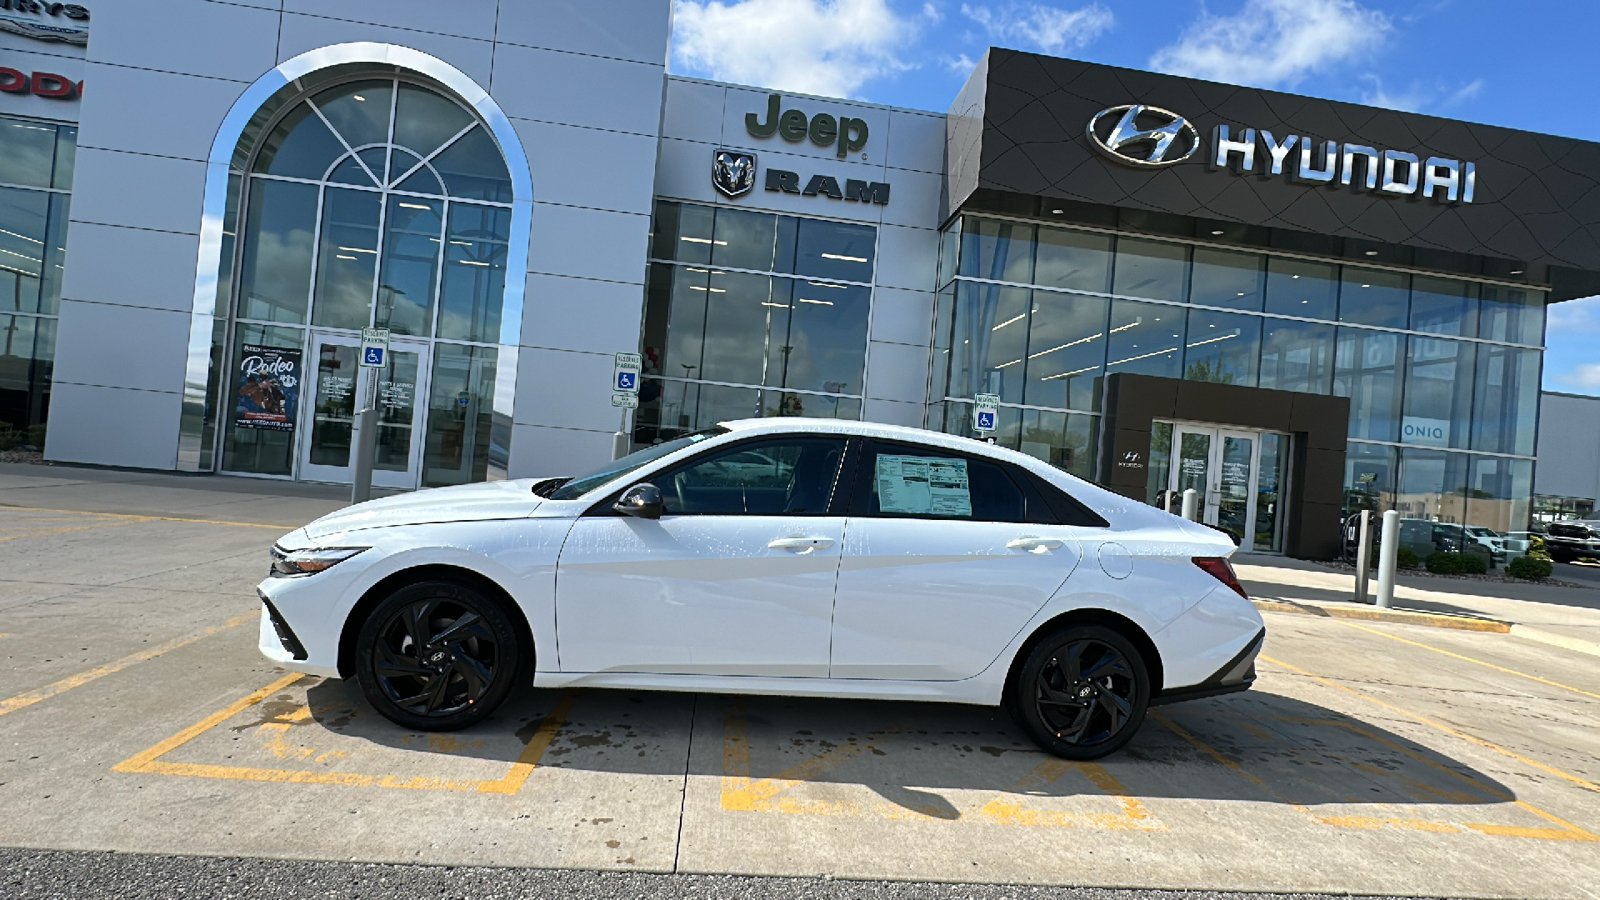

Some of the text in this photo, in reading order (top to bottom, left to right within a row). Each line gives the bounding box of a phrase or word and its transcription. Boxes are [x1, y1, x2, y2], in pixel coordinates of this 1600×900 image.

[0, 66, 84, 97] OD
[745, 93, 869, 158] Jeep
[1213, 124, 1476, 204] HYUNDAI
[765, 168, 891, 205] RAM
[363, 336, 387, 344] PARKING
[241, 356, 294, 377] Rodeo
